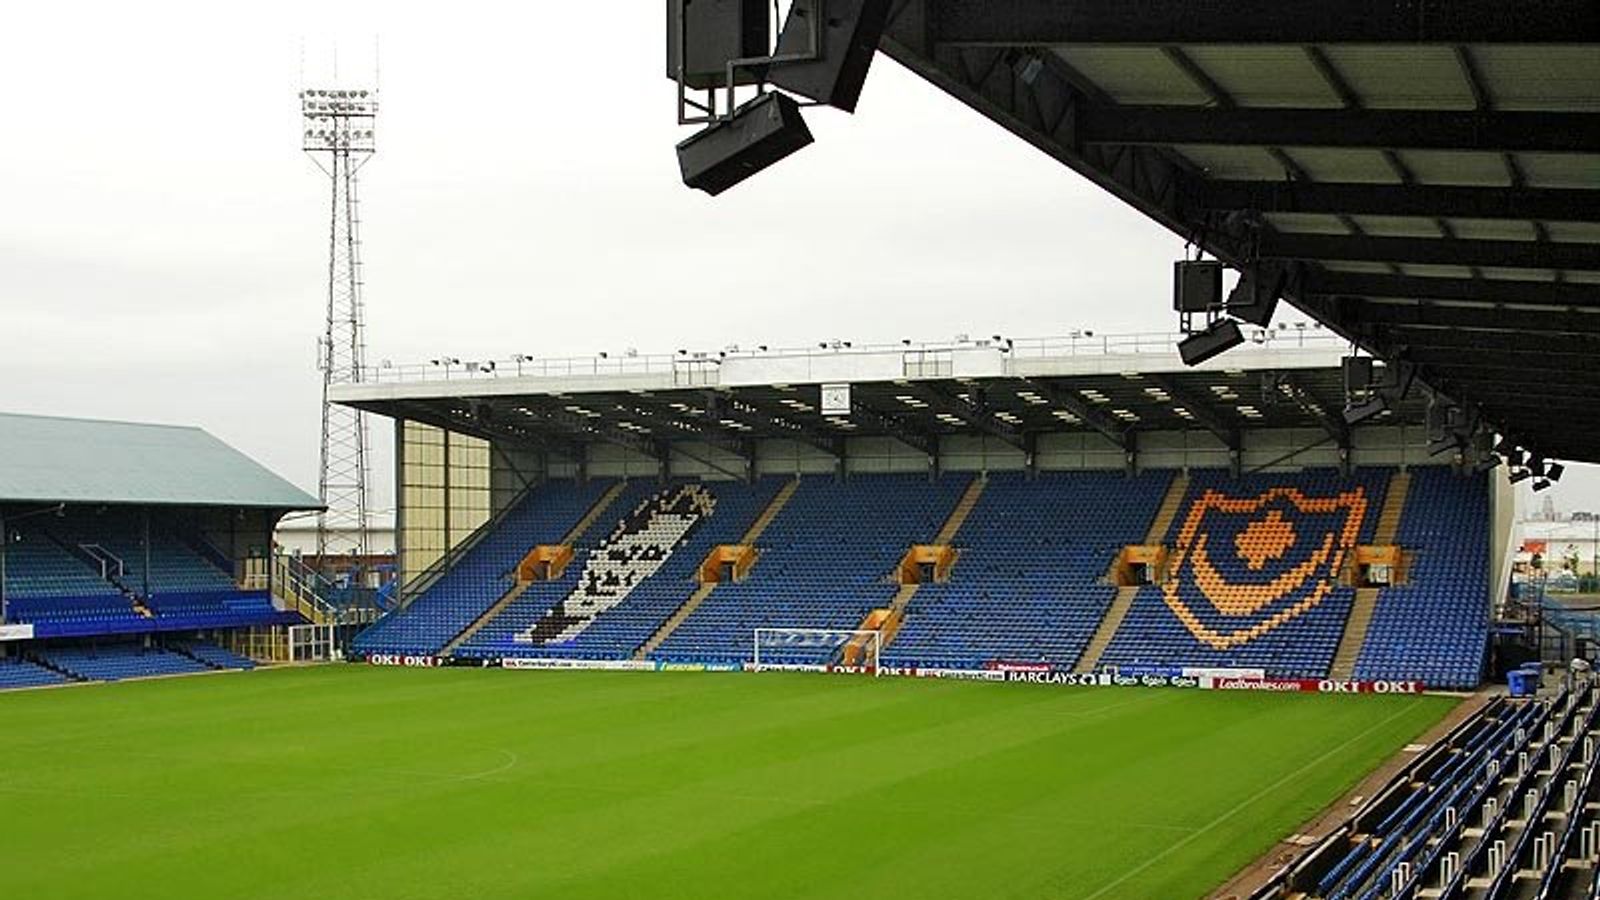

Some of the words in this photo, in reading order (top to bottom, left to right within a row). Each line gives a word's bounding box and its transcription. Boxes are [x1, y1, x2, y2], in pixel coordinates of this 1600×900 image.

[371, 655, 400, 665] OKI
[404, 656, 433, 666] OKI
[1010, 672, 1077, 685] BARCLAYS
[1219, 679, 1301, 691] Ladbrokes.com
[1317, 680, 1360, 692] OKI
[1374, 681, 1416, 693] OKI
